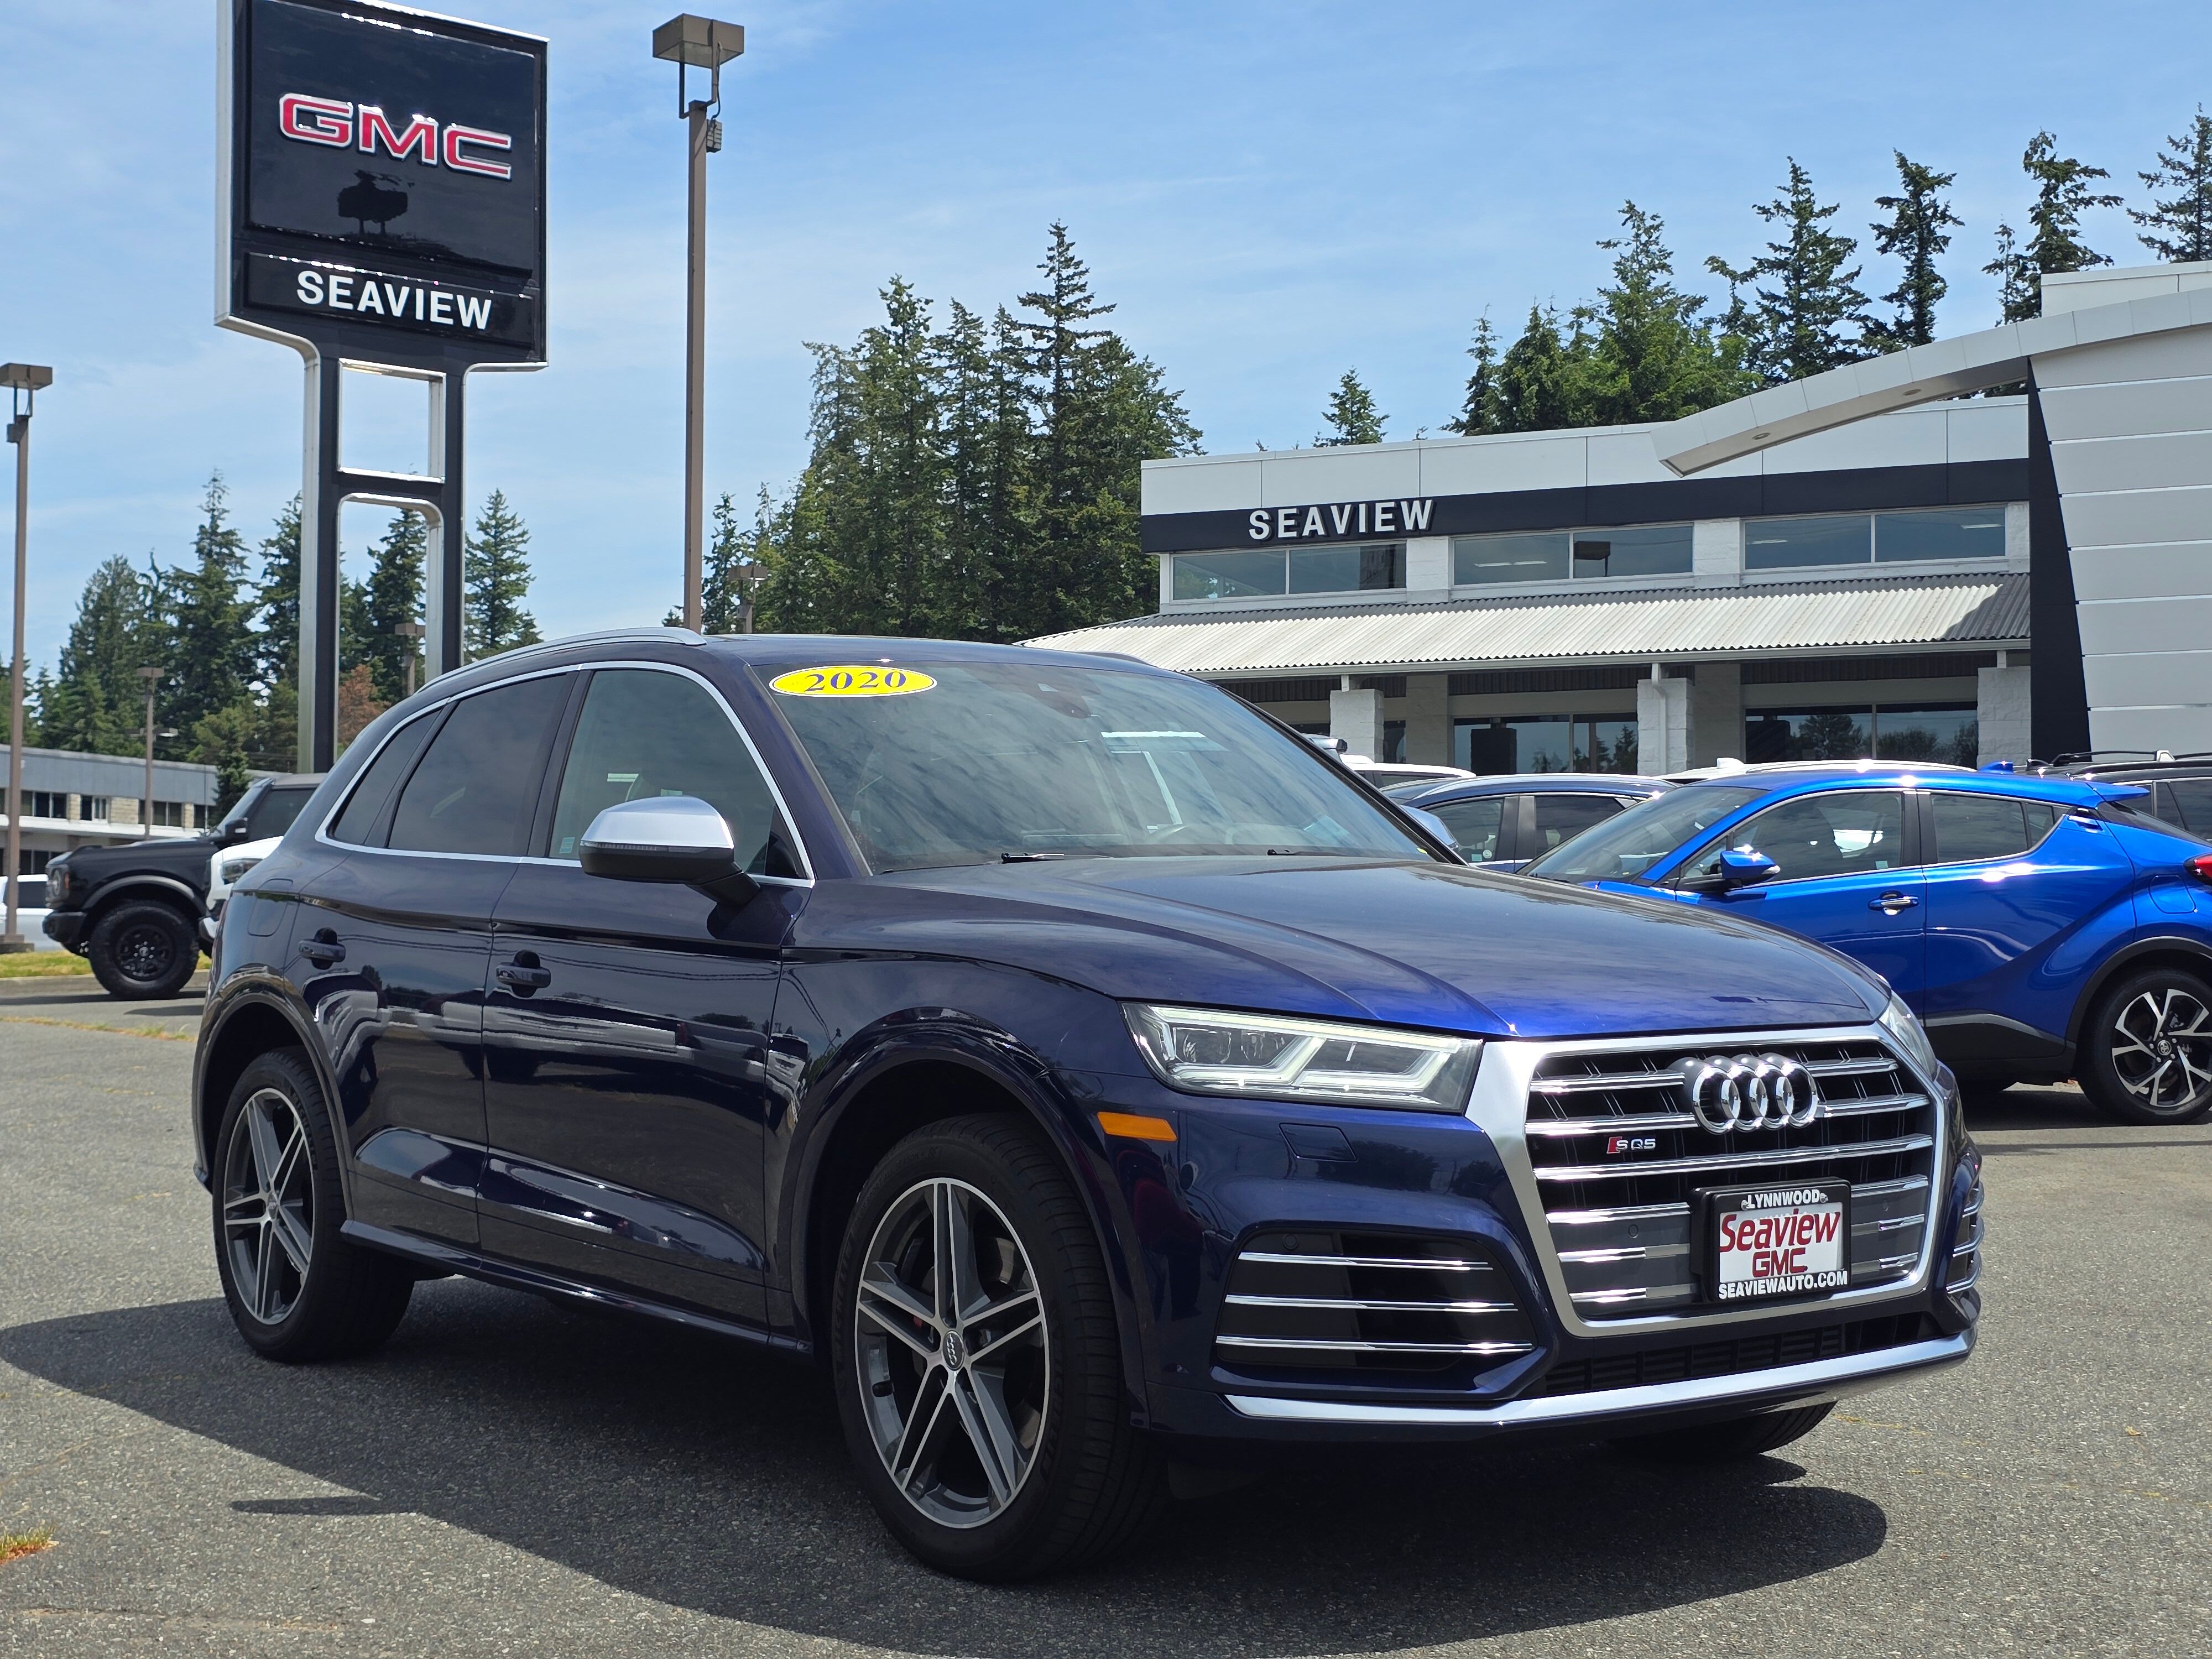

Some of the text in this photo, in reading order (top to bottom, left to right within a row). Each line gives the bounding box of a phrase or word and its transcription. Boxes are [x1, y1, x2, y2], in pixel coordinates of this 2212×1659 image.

[279, 93, 511, 179] GMC
[296, 270, 492, 330] SEAVIEW
[1249, 499, 1434, 540] SEAVIEW
[804, 671, 906, 692] 2020
[1615, 1138, 1656, 1151] SQ5
[1746, 1189, 1820, 1209] LYNNWOOD
[1719, 1208, 1841, 1253] Seaview
[1752, 1248, 1808, 1277] GMC
[1718, 1271, 1848, 1300] SEAVIEWAUTO.COM
